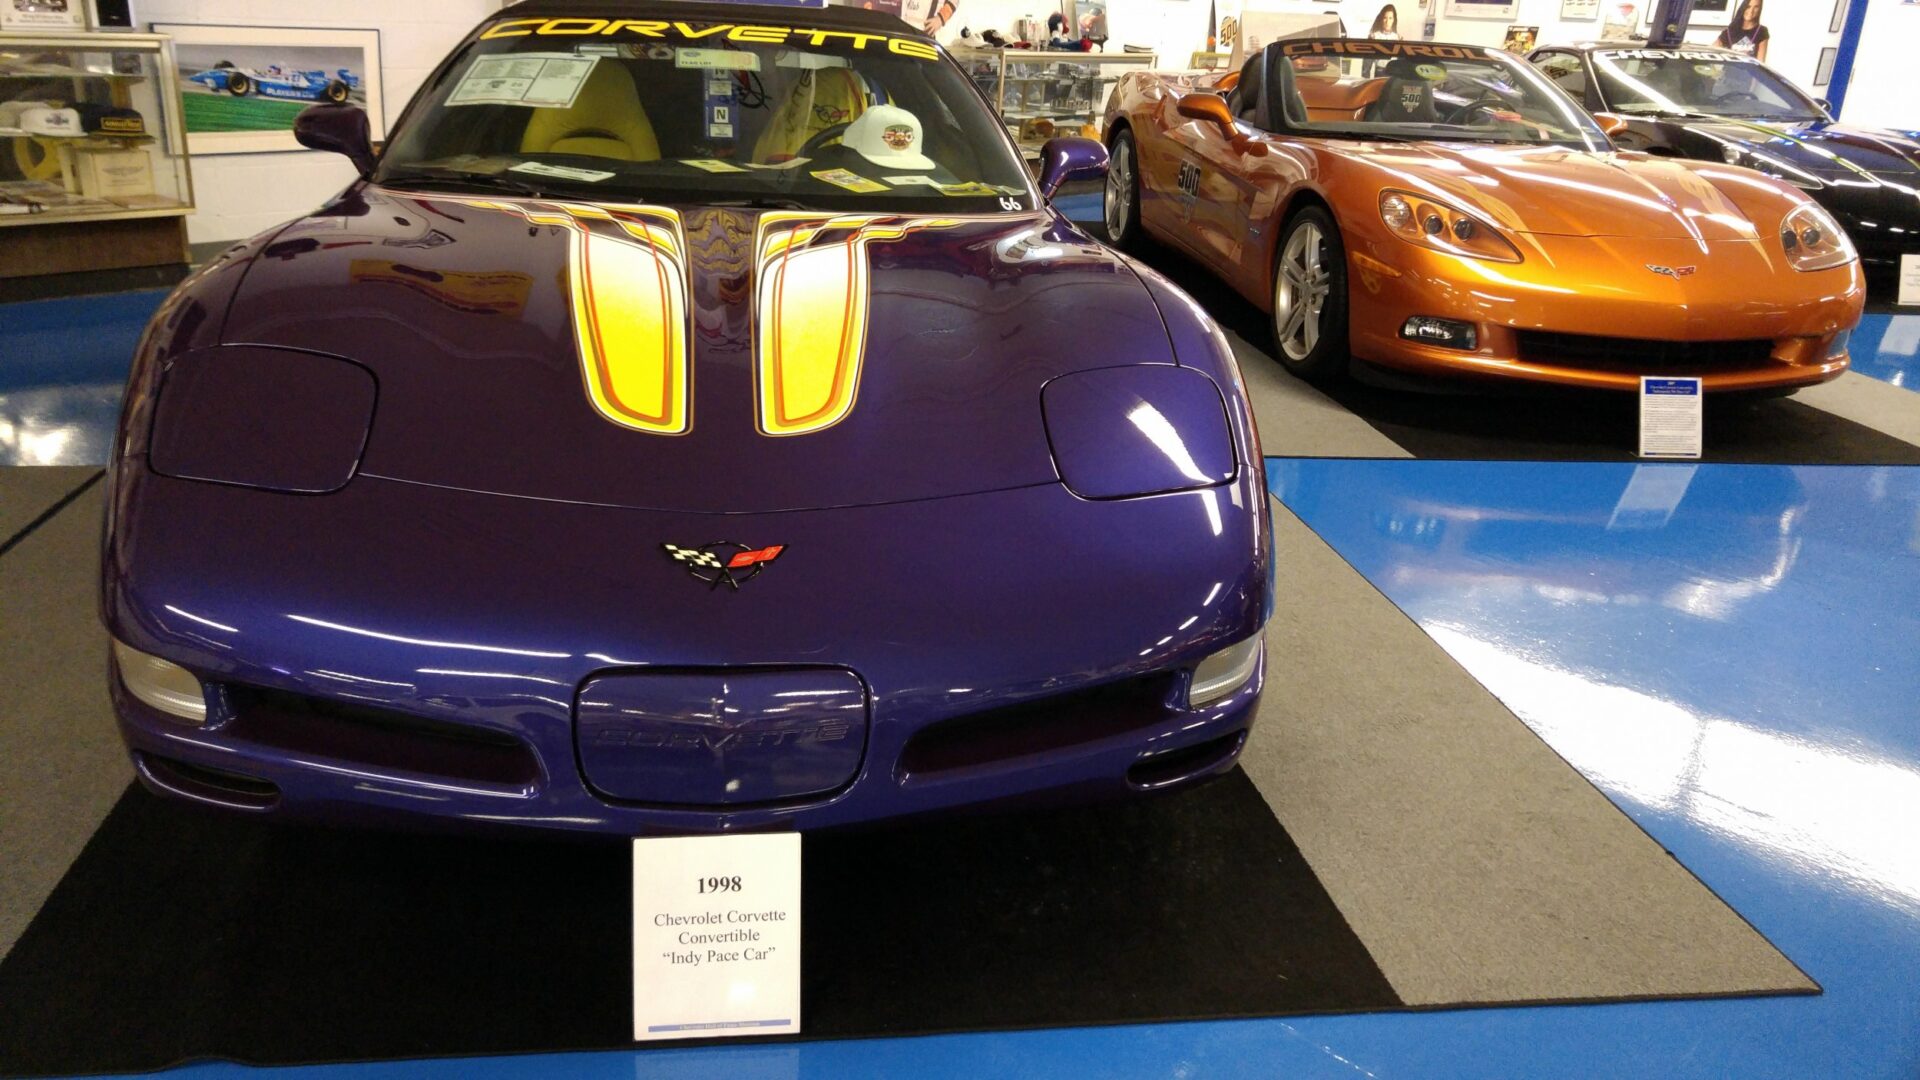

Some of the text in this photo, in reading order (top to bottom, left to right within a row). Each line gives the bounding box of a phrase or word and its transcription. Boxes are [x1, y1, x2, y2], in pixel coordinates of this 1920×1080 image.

[479, 18, 939, 61] CORVETTE
[1220, 19, 1238, 45] 500
[1283, 41, 1499, 61] CHEVROL
[1400, 93, 1421, 103] 500
[1177, 158, 1201, 198] 500
[594, 720, 849, 750] CORVETTE
[697, 875, 742, 894] 1998
[654, 909, 786, 926] Chevrolet Corvette
[678, 928, 760, 944] Convertible
[707, 949, 739, 962] Pace
